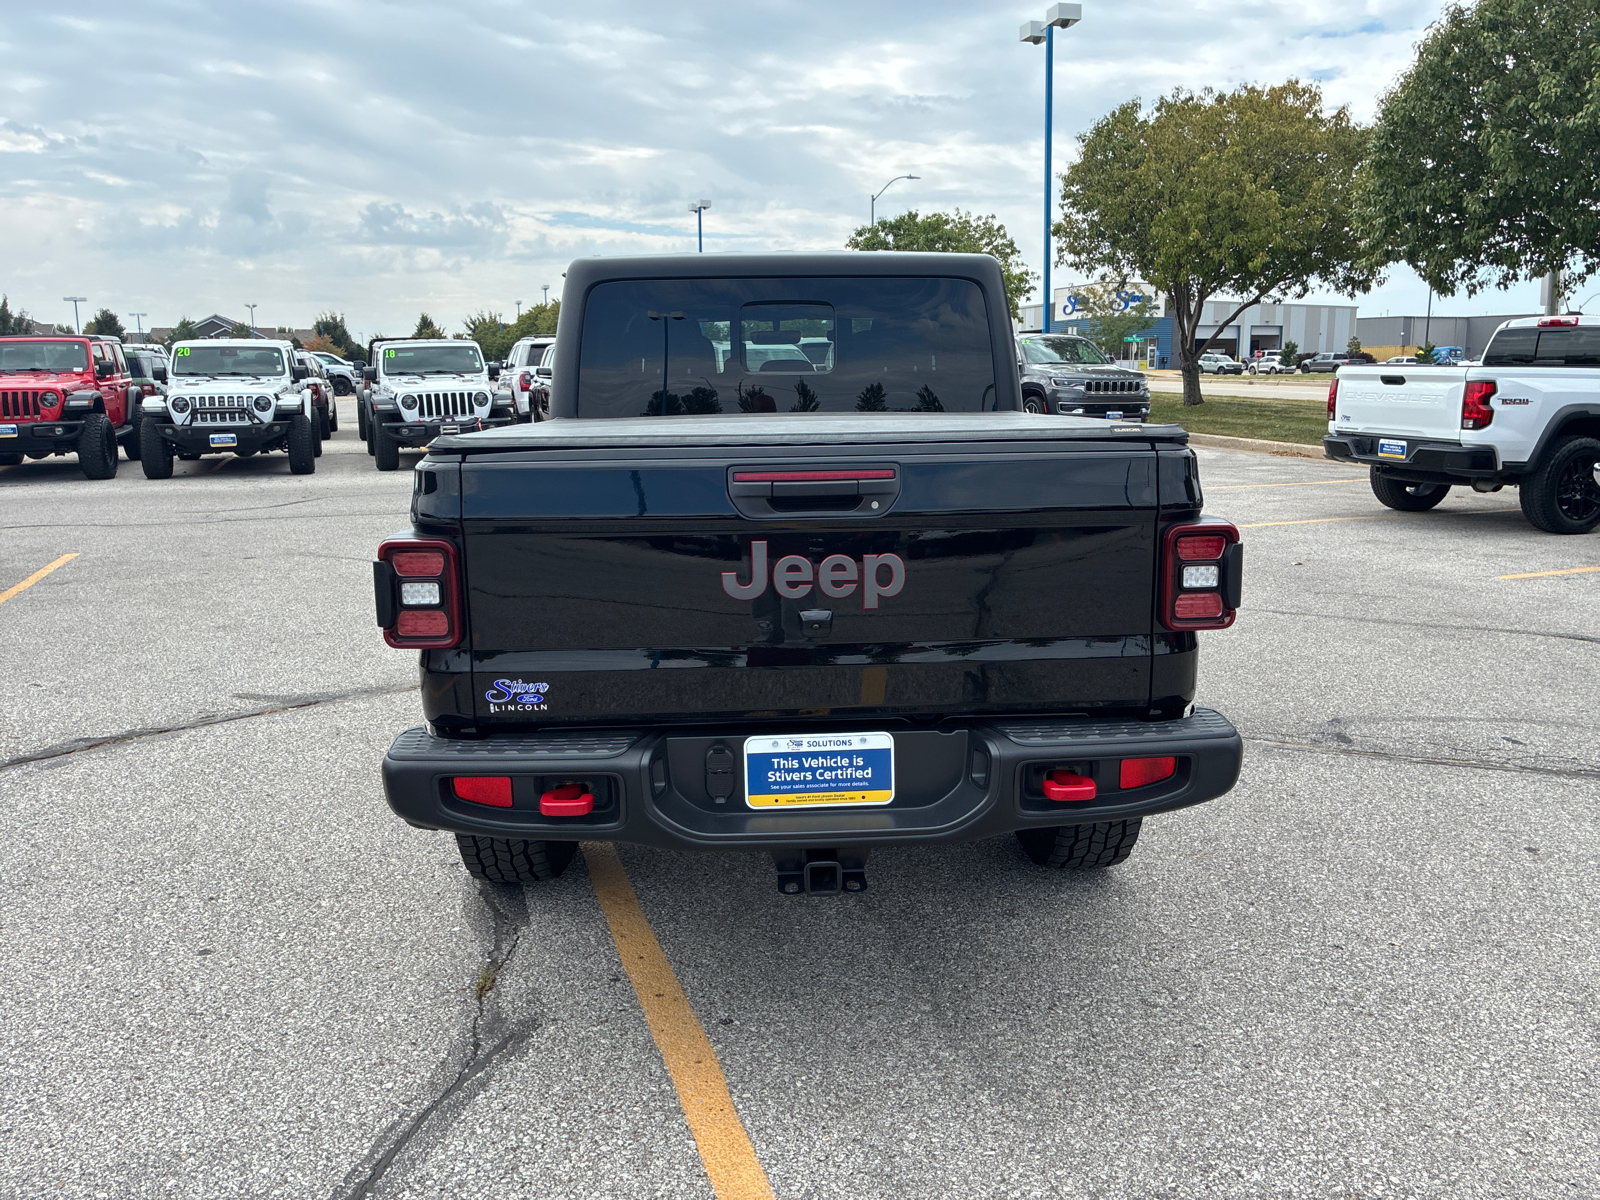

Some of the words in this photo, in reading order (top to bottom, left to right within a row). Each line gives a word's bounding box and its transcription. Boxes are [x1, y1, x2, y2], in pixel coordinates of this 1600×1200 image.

[177, 347, 191, 357] 20
[384, 349, 396, 358] 18
[1344, 391, 1444, 404] CHEVROLET
[721, 540, 906, 610] Jeep
[485, 678, 550, 703] Stivers
[806, 739, 853, 748] SOLUTIONS
[771, 757, 799, 769] This
[802, 756, 849, 768] Vehicle
[852, 755, 864, 766] is
[767, 770, 812, 782] Stivers
[815, 767, 872, 780] Certified
